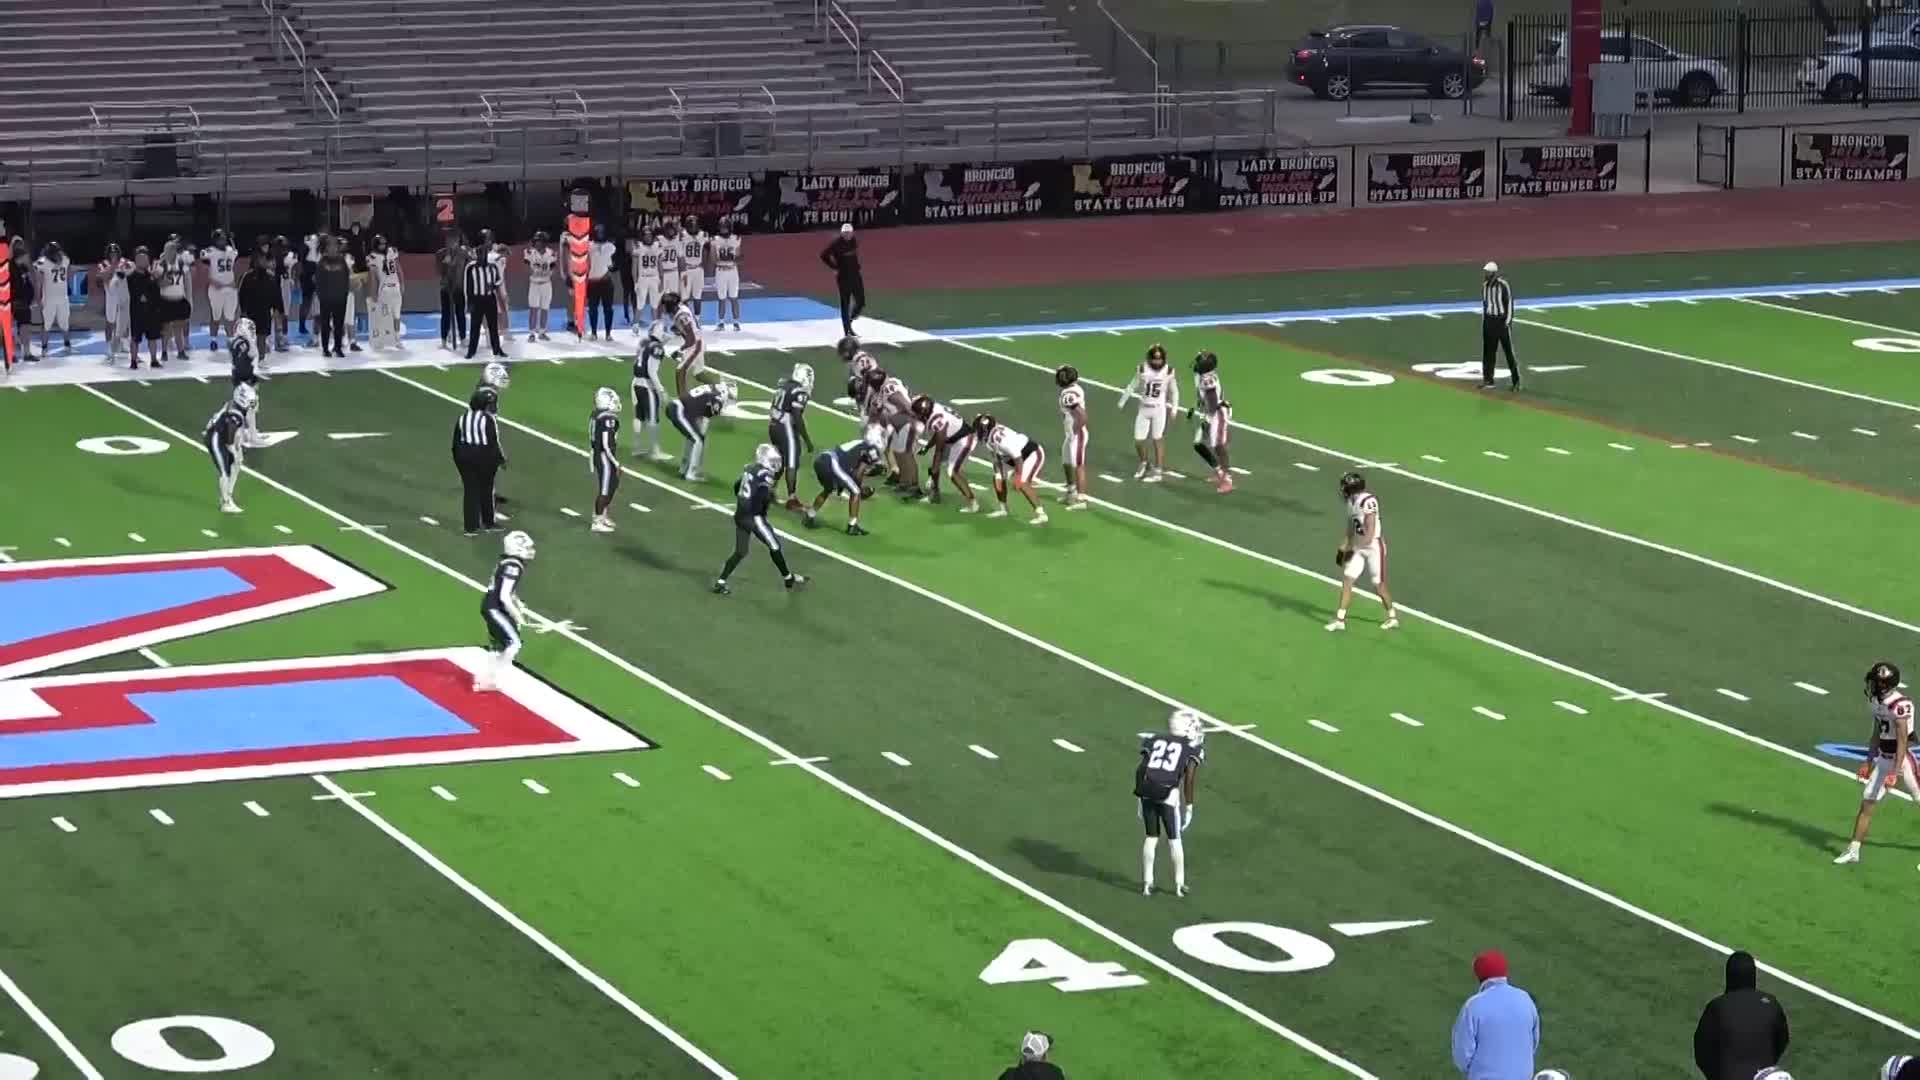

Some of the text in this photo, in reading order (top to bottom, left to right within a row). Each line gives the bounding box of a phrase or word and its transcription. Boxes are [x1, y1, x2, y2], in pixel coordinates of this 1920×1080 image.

[1241, 157, 1336, 173] LADY BRONCOS
[1796, 167, 1902, 180] STATE CHAMPS
[651, 179, 689, 193] LADY
[802, 176, 835, 190] LADY
[1504, 179, 1615, 194] STATE RUNNER-UP
[1219, 191, 1336, 206] STATE RUNNER-UP
[1370, 185, 1482, 201] STATE RUNNER-UP
[436, 199, 454, 221] 2
[925, 203, 964, 218] STATE
[1074, 195, 1184, 212] STATE CHAMPS
[1148, 739, 1182, 771] 23
